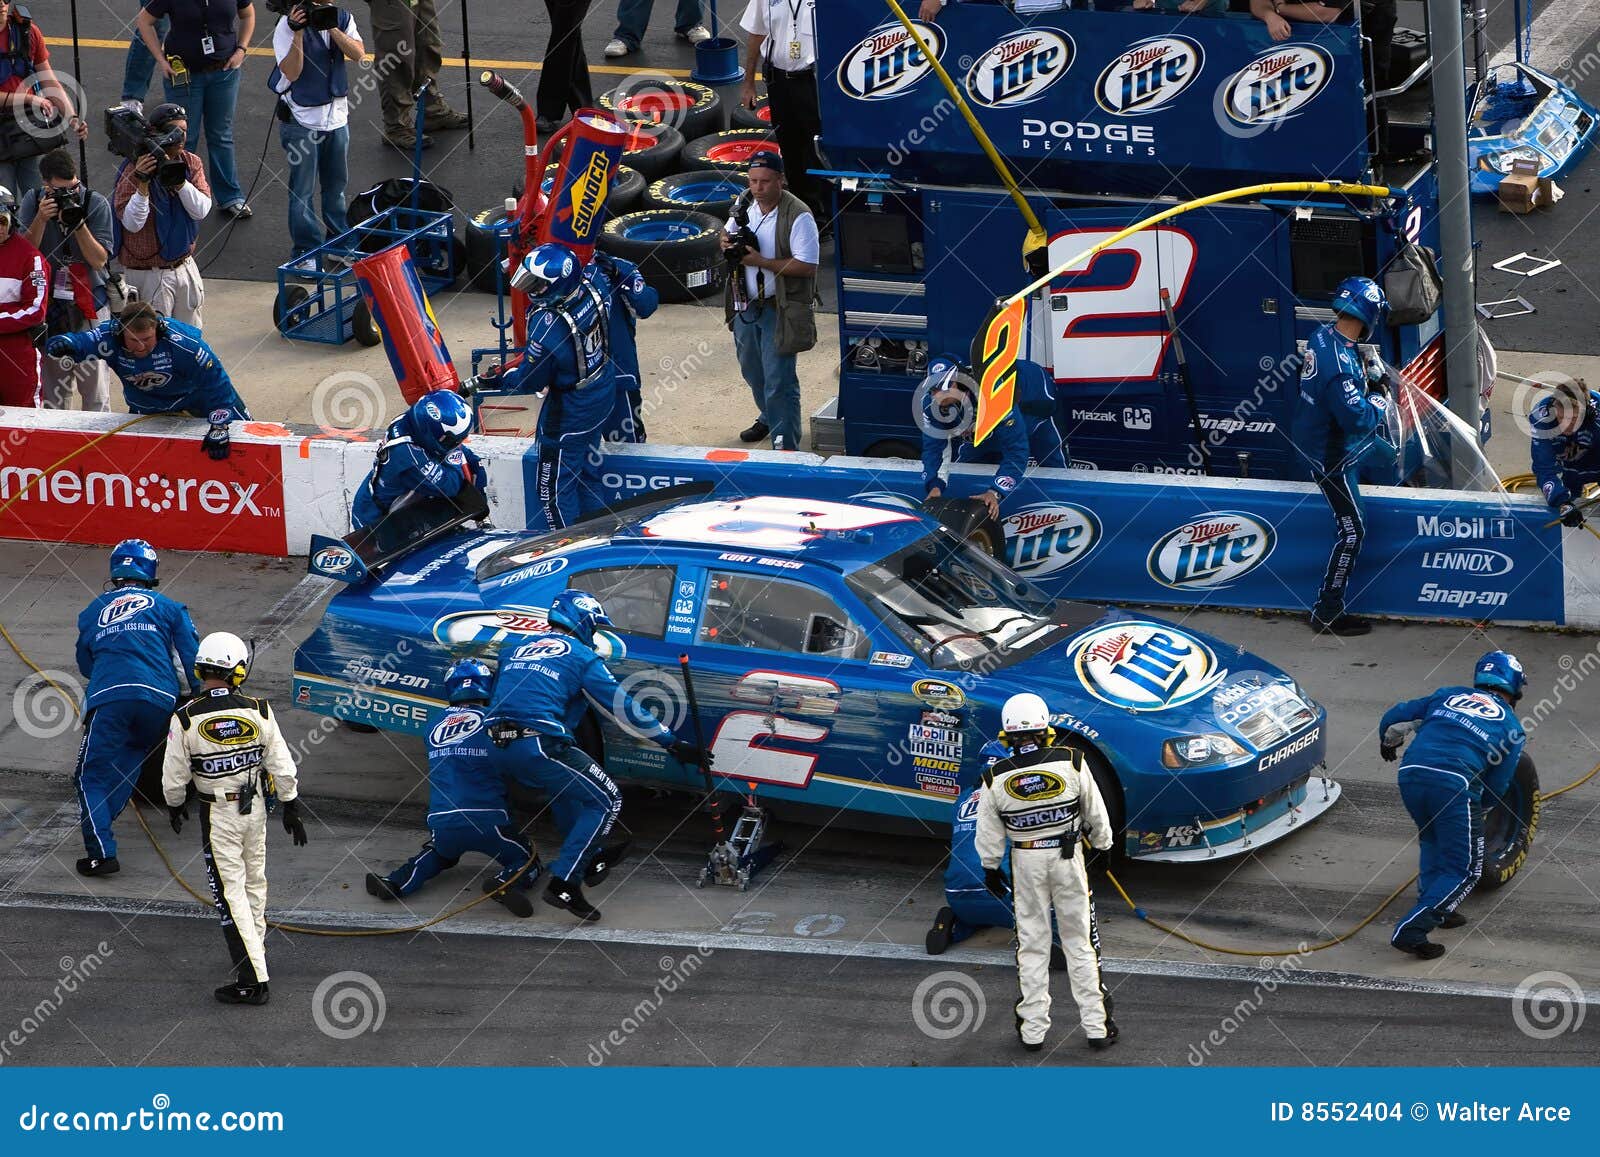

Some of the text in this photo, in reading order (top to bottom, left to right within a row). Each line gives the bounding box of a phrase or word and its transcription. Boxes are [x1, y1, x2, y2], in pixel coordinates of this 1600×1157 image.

[992, 38, 1044, 63] Miller
[1121, 46, 1173, 71] Miller
[990, 46, 1059, 105] Lite
[1249, 54, 1302, 80] Miller
[1119, 53, 1188, 112] Lite
[1248, 62, 1316, 121] Lite
[1022, 119, 1155, 143] DODGE
[1022, 139, 1156, 156] DEALERS
[574, 155, 608, 235] SUNOCO
[1340, 289, 1351, 298] 2
[1018, 226, 1199, 384] 2
[973, 295, 1025, 448] 2
[1072, 408, 1118, 423] Mazak
[1123, 407, 1152, 430] PPG
[0, 465, 263, 517] memorex
[601, 473, 694, 490] ODGE
[1008, 513, 1067, 534] Miller
[1182, 522, 1241, 543] Miller
[1417, 515, 1485, 539] Mobil
[1005, 524, 1084, 572] Lite
[1174, 533, 1258, 584] Lite
[122, 557, 133, 566] 2
[319, 555, 349, 569] Lite
[718, 552, 804, 570] KURT BUSCH
[1421, 552, 1495, 572] LENNOX
[500, 558, 555, 587] LENNOX
[1418, 583, 1509, 608] Snap-on
[668, 624, 692, 635] Mazak
[1081, 632, 1130, 664] Miller
[342, 660, 430, 689] Snap-on
[1110, 632, 1192, 705] Lite
[1483, 663, 1495, 672] 2
[462, 678, 472, 688] 2
[335, 695, 428, 722] DODGE
[219, 728, 241, 738] Sprint
[912, 725, 945, 741] Mobil
[911, 741, 962, 759] MAHLE
[1258, 727, 1320, 772] CHARGER
[202, 751, 263, 773] OFFICIAL
[913, 756, 961, 772] MOOG
[918, 774, 953, 786] LINCOLN
[1024, 783, 1046, 793] Sprint
[1009, 808, 1071, 828] OFFICIAL
[1033, 839, 1060, 848] NASCAR
